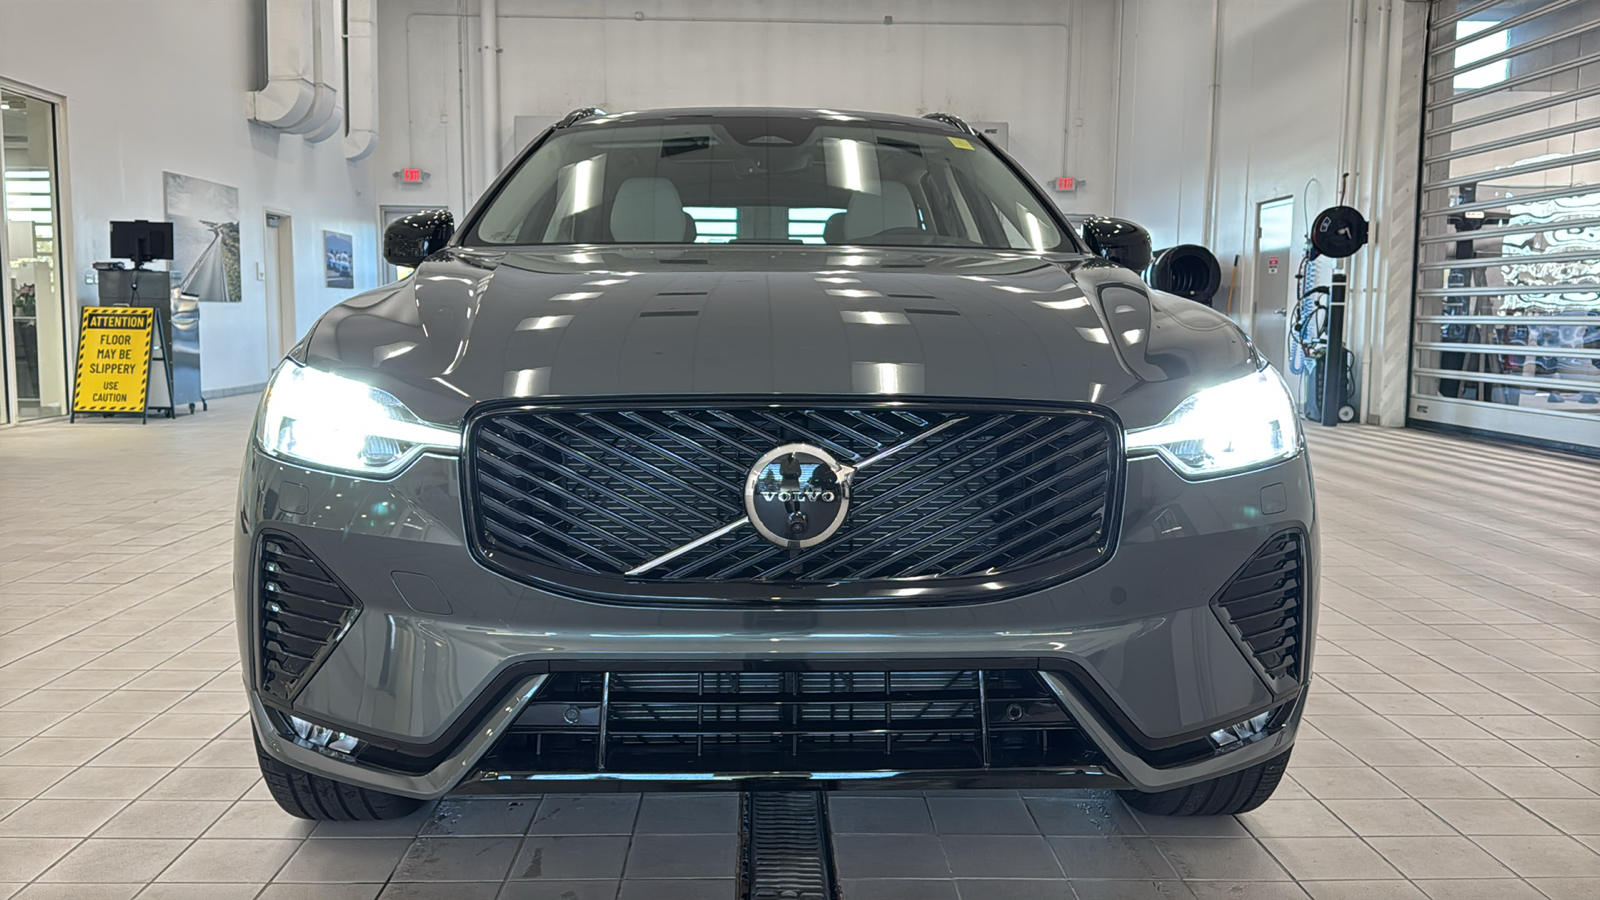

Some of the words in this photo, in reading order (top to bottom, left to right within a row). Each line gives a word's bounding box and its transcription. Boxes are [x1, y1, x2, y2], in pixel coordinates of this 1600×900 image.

[404, 169, 420, 182] EXIT
[89, 316, 144, 328] ATTENTION
[100, 334, 131, 345] FLOOR
[97, 349, 117, 360] MAY
[119, 349, 132, 360] BE
[89, 363, 136, 374] SLIPPERY
[103, 381, 119, 390] USE
[92, 393, 127, 403] CAUTION
[760, 491, 835, 502] VOLVO
